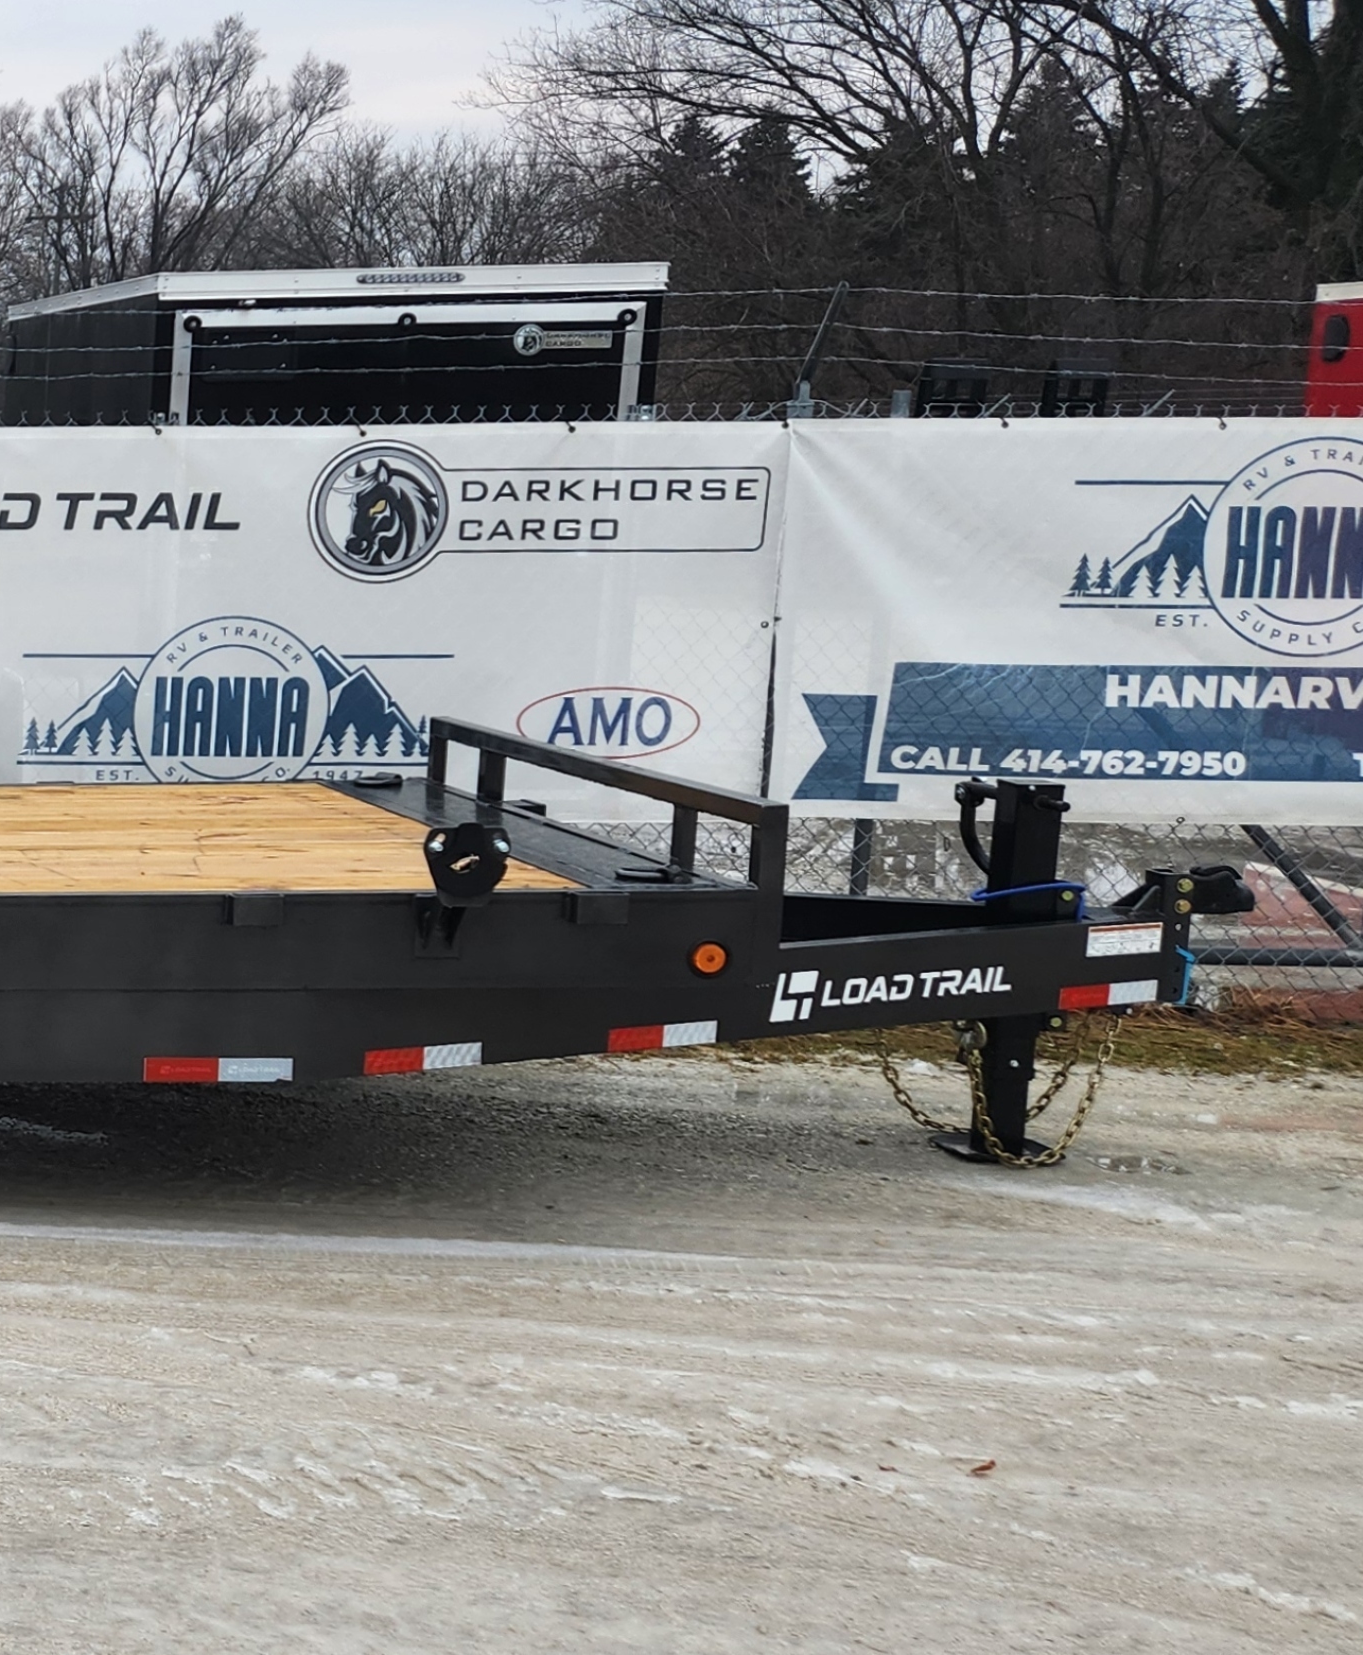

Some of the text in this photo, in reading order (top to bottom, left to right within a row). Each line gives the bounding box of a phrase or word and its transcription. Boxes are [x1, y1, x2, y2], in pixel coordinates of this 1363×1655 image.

[461, 479, 760, 502] DARKHORSE
[1242, 466, 1270, 492] RV
[1284, 455, 1296, 467] &
[56, 492, 241, 531] TRAIL
[458, 518, 620, 541] CARGO
[1154, 613, 1208, 627] EST.
[1236, 609, 1333, 646] SUPPLY
[166, 625, 304, 665] RV & TRAILER
[1104, 673, 1363, 710] HANNARV
[150, 675, 310, 757] HANNA
[547, 696, 673, 748] AMO
[95, 769, 140, 782] EST.
[312, 770, 363, 782] 1947
[890, 745, 1247, 777] CALL 414-762-7950
[821, 966, 1012, 1007] LOAD TRAIL
